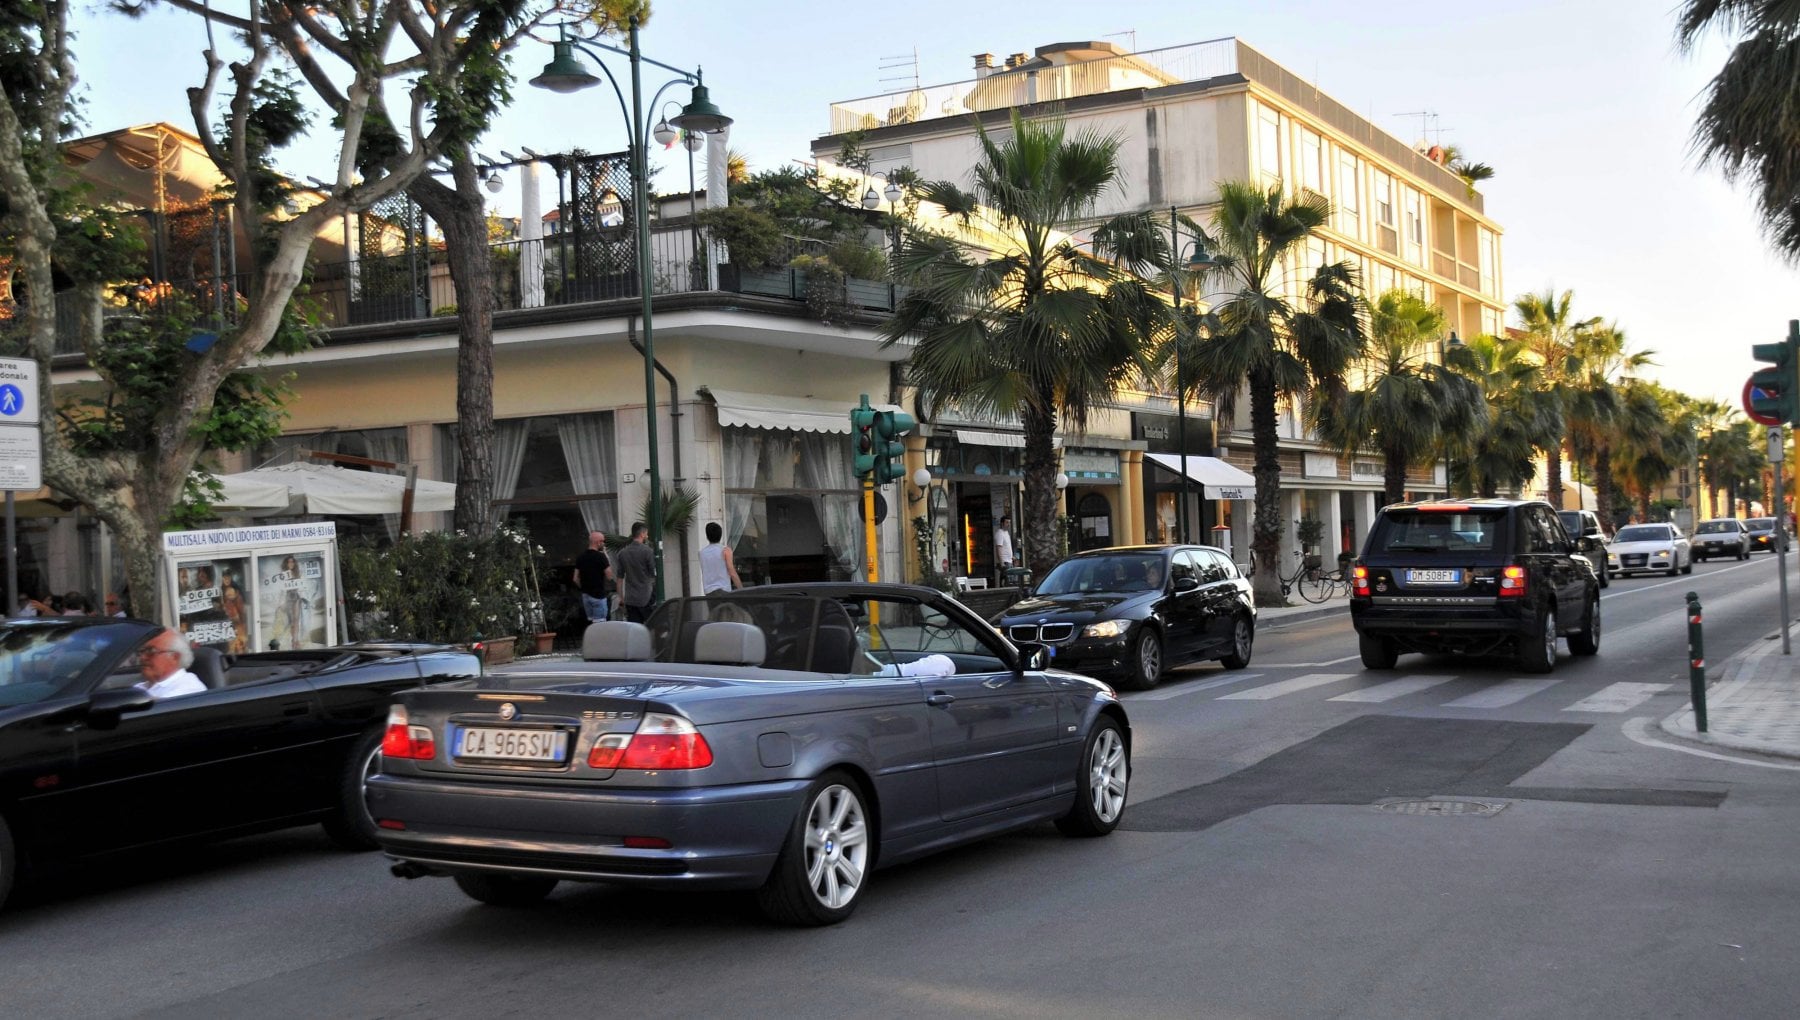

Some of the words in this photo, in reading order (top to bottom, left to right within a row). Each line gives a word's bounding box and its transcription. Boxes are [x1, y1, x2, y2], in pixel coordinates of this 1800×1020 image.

[168, 533, 207, 546] MULTISALA
[208, 531, 234, 544] NUOVO
[235, 530, 252, 542] LIDO
[252, 530, 270, 541] FORTE
[271, 529, 280, 539] DEI
[282, 528, 302, 538] MARMI
[189, 589, 218, 599] OGGI
[194, 622, 221, 632] PRINCE
[222, 621, 233, 629] OF
[185, 627, 236, 642] PERSIA
[465, 731, 487, 754] CA
[494, 731, 553, 757] 966SW
